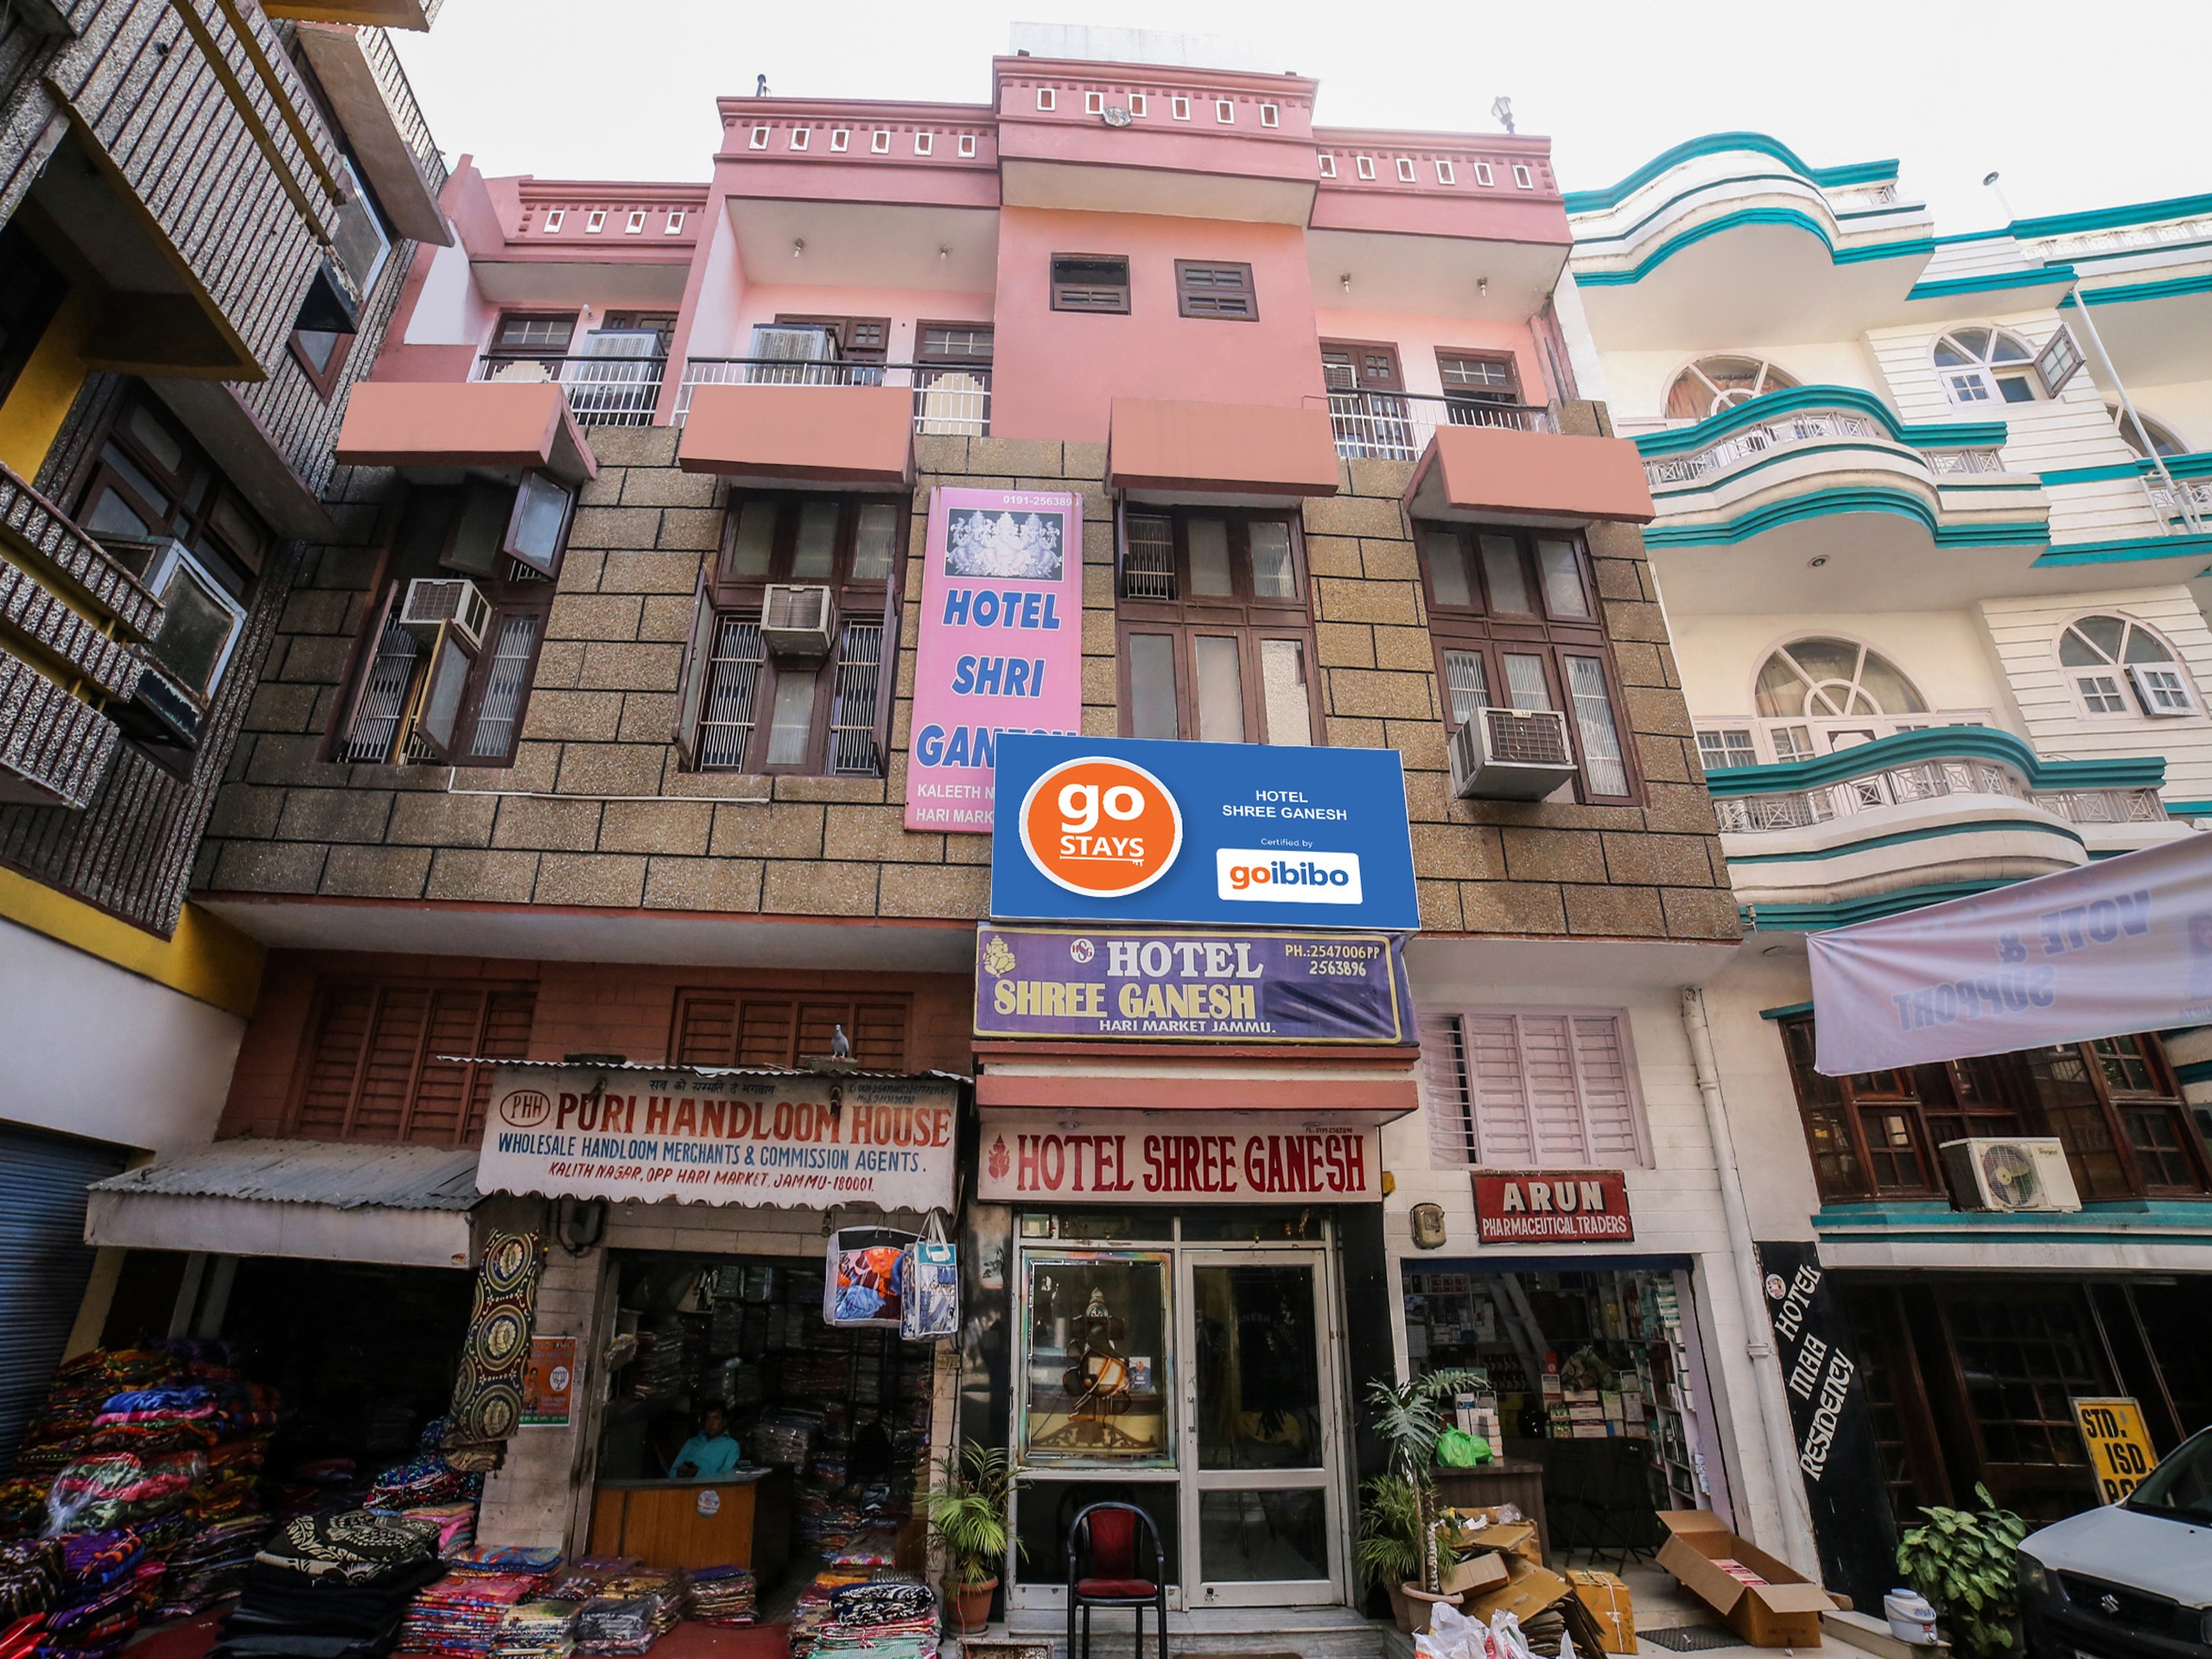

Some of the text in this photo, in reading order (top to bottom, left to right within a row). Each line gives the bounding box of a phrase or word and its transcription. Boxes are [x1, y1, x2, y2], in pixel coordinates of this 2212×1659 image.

[942, 588, 1061, 632] HOTEL
[950, 654, 1046, 698] SHRI
[916, 723, 1078, 768] GAN
[917, 784, 981, 799] KALEETH
[1255, 790, 1309, 804] HOTEL
[916, 808, 994, 824] HARI MARK
[1058, 783, 1146, 834] go
[1222, 804, 1348, 822] SHREE GANESH
[1060, 835, 1145, 857] STAYS
[1261, 837, 1313, 849] Certified by
[1230, 861, 1350, 890] goibibo
[1106, 940, 1264, 979] HOTEL
[1308, 960, 1367, 977] 2563896
[994, 979, 1256, 1020] SHREE GANESH
[1099, 1020, 1277, 1033] HARI MARKET JAMMU.
[556, 1092, 952, 1148] PURI HANDLOOM HOUSE
[499, 1132, 577, 1157] WHOLESALE
[581, 1137, 658, 1161] HANDLOOM
[663, 1141, 741, 1166] MERCHANTS
[744, 1146, 755, 1166] &
[760, 1147, 849, 1171] COMMISSION
[1017, 1134, 1367, 1193] HOTEL SHREE GANESH
[549, 1161, 593, 1179] KALITH
[646, 1167, 673, 1183] OPP
[677, 1168, 710, 1184] HARI
[1503, 1180, 1605, 1213] ARUN
[1483, 1215, 1628, 1236] PHARMACEUTICAL TRADERS
[1775, 1263, 1822, 1342] HOTEL
[1799, 1347, 1855, 1482] RESIDENCY
[2081, 1408, 2128, 1439] STD.
